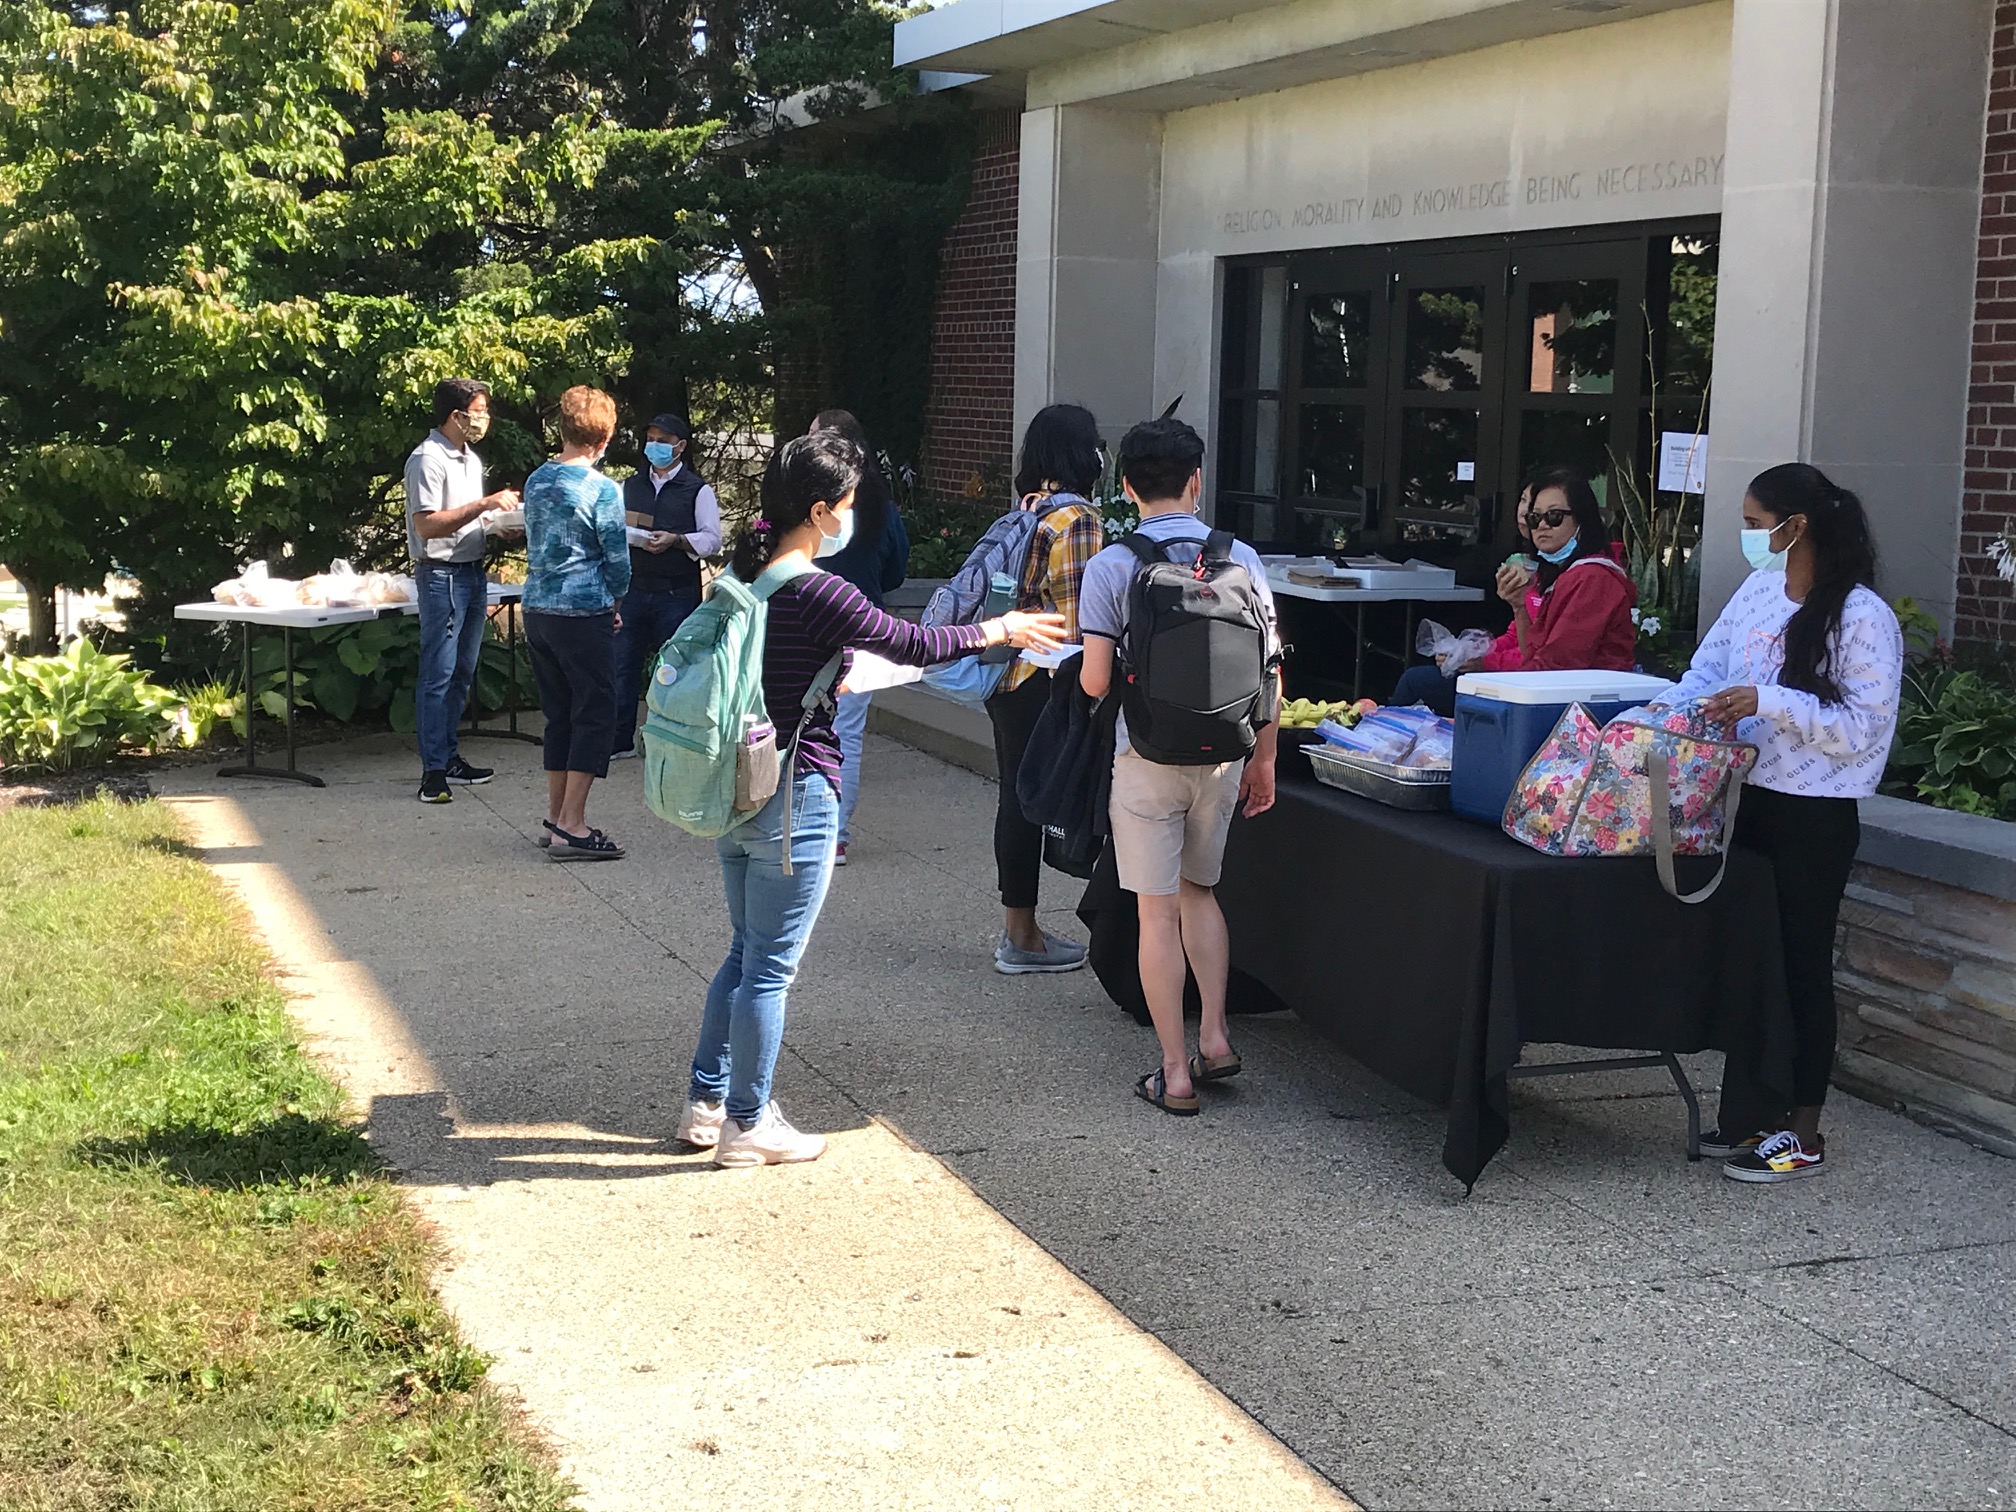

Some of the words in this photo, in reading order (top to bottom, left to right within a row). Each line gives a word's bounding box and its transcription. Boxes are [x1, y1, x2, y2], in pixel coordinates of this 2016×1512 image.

[1292, 198, 1364, 229] MORALITY
[1371, 194, 1402, 221] AND
[1413, 181, 1511, 216] KNOWLEDGE
[1526, 172, 1581, 205] BEING
[1856, 745, 1885, 768] GUESS
[1786, 757, 1816, 779] GUESS
[1820, 761, 1848, 783] GUESS
